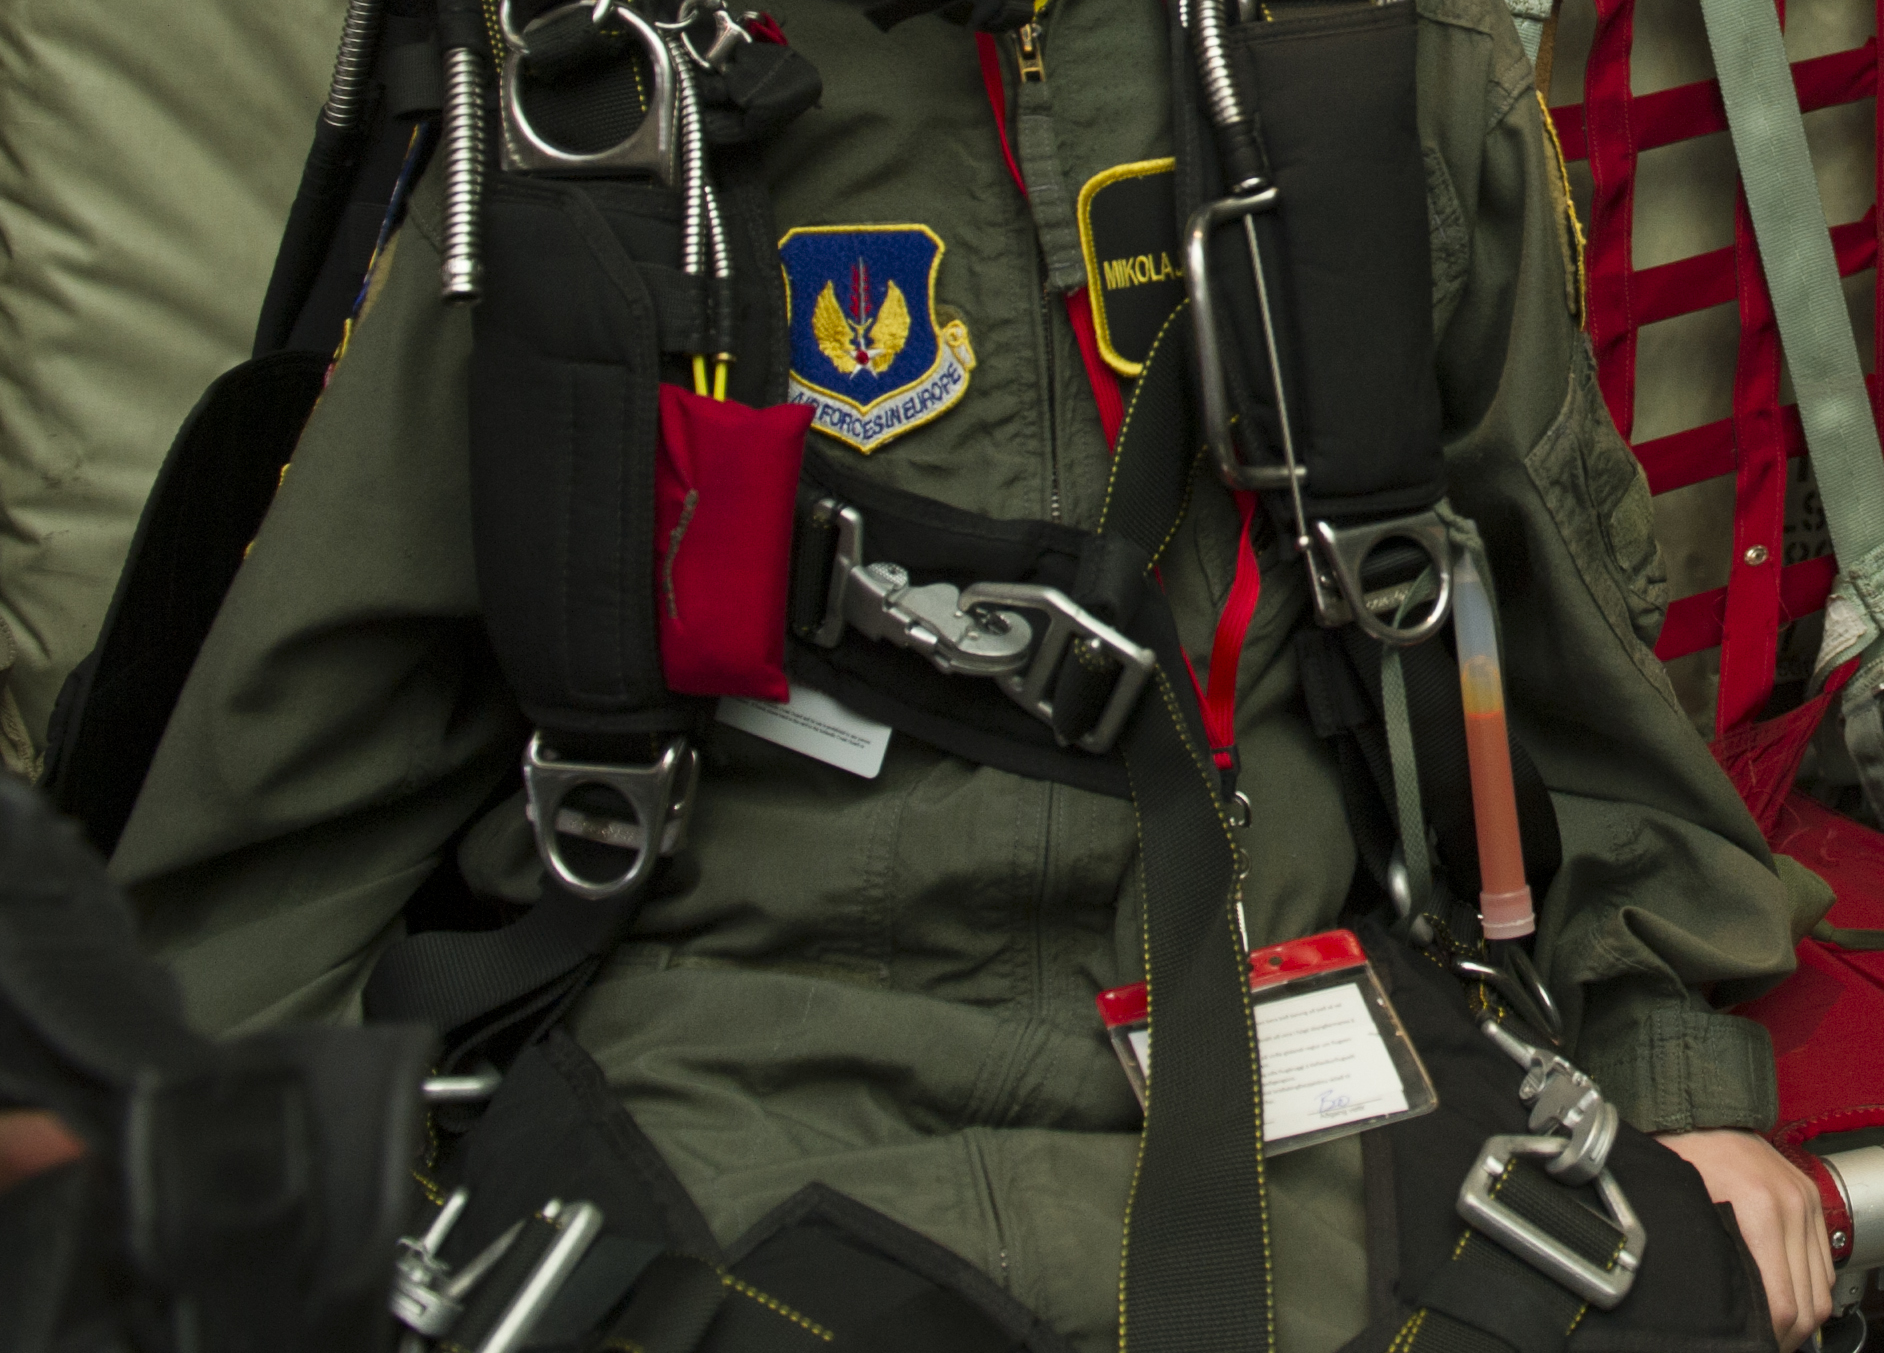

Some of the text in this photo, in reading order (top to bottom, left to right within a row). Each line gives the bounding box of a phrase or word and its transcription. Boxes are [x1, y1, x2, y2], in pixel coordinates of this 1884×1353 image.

[818, 402, 884, 441] FORCES
[884, 404, 903, 429] IN
[902, 361, 962, 421] EUROPE
